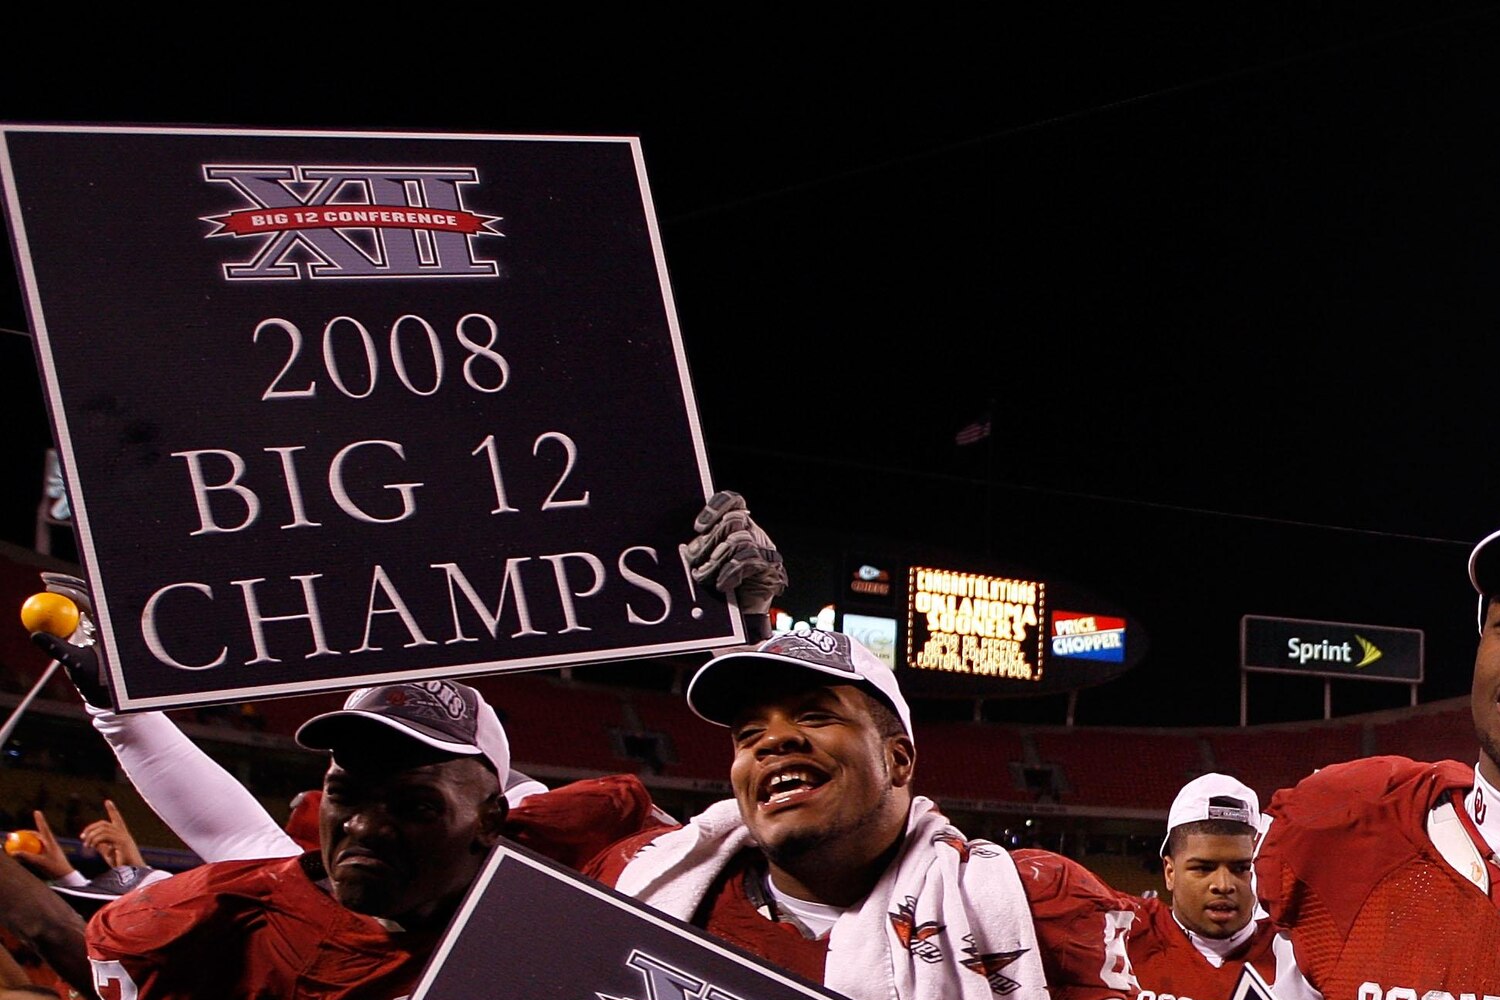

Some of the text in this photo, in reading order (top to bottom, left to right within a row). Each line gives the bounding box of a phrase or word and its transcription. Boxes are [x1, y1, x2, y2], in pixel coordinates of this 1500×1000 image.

[251, 210, 459, 228] BIG 12 CONFERENCE
[252, 313, 511, 401] 2008
[171, 431, 591, 537] BIG 12
[141, 542, 705, 672] CHAMPS!
[915, 592, 1038, 626] OKLAHOMA
[927, 611, 1027, 641] SOONERS
[1055, 616, 1097, 635] PRICE
[1052, 632, 1122, 656] CHOPPER
[1287, 637, 1352, 664] Sprint
